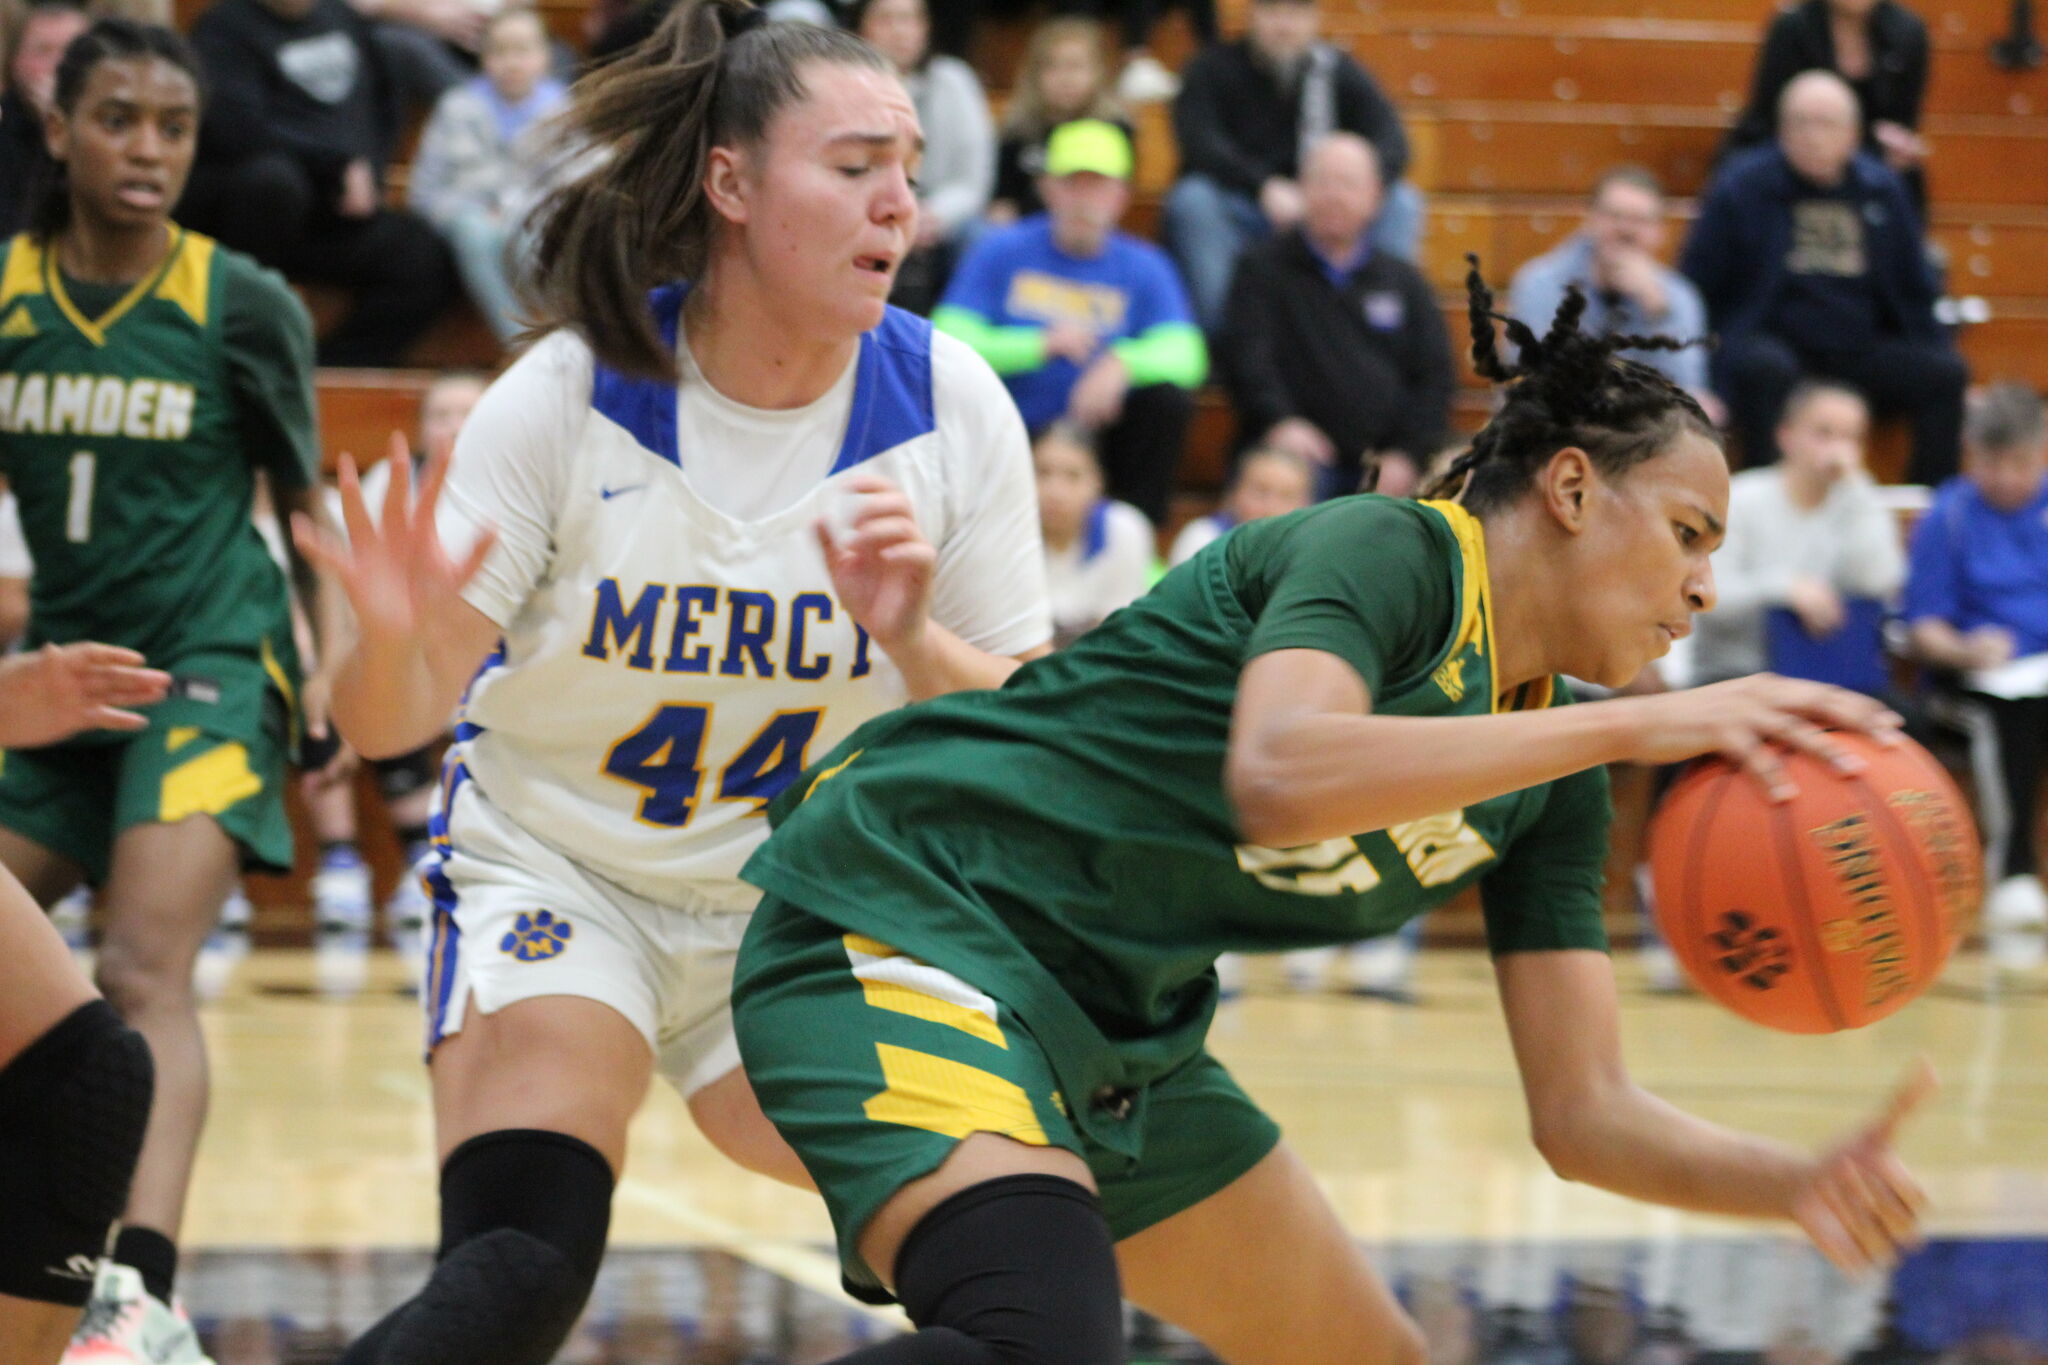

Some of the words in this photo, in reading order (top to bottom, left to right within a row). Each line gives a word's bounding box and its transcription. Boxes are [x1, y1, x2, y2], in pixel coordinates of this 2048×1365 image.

[65, 451, 96, 543] 1
[599, 701, 827, 829] 44
[525, 937, 554, 957] M
